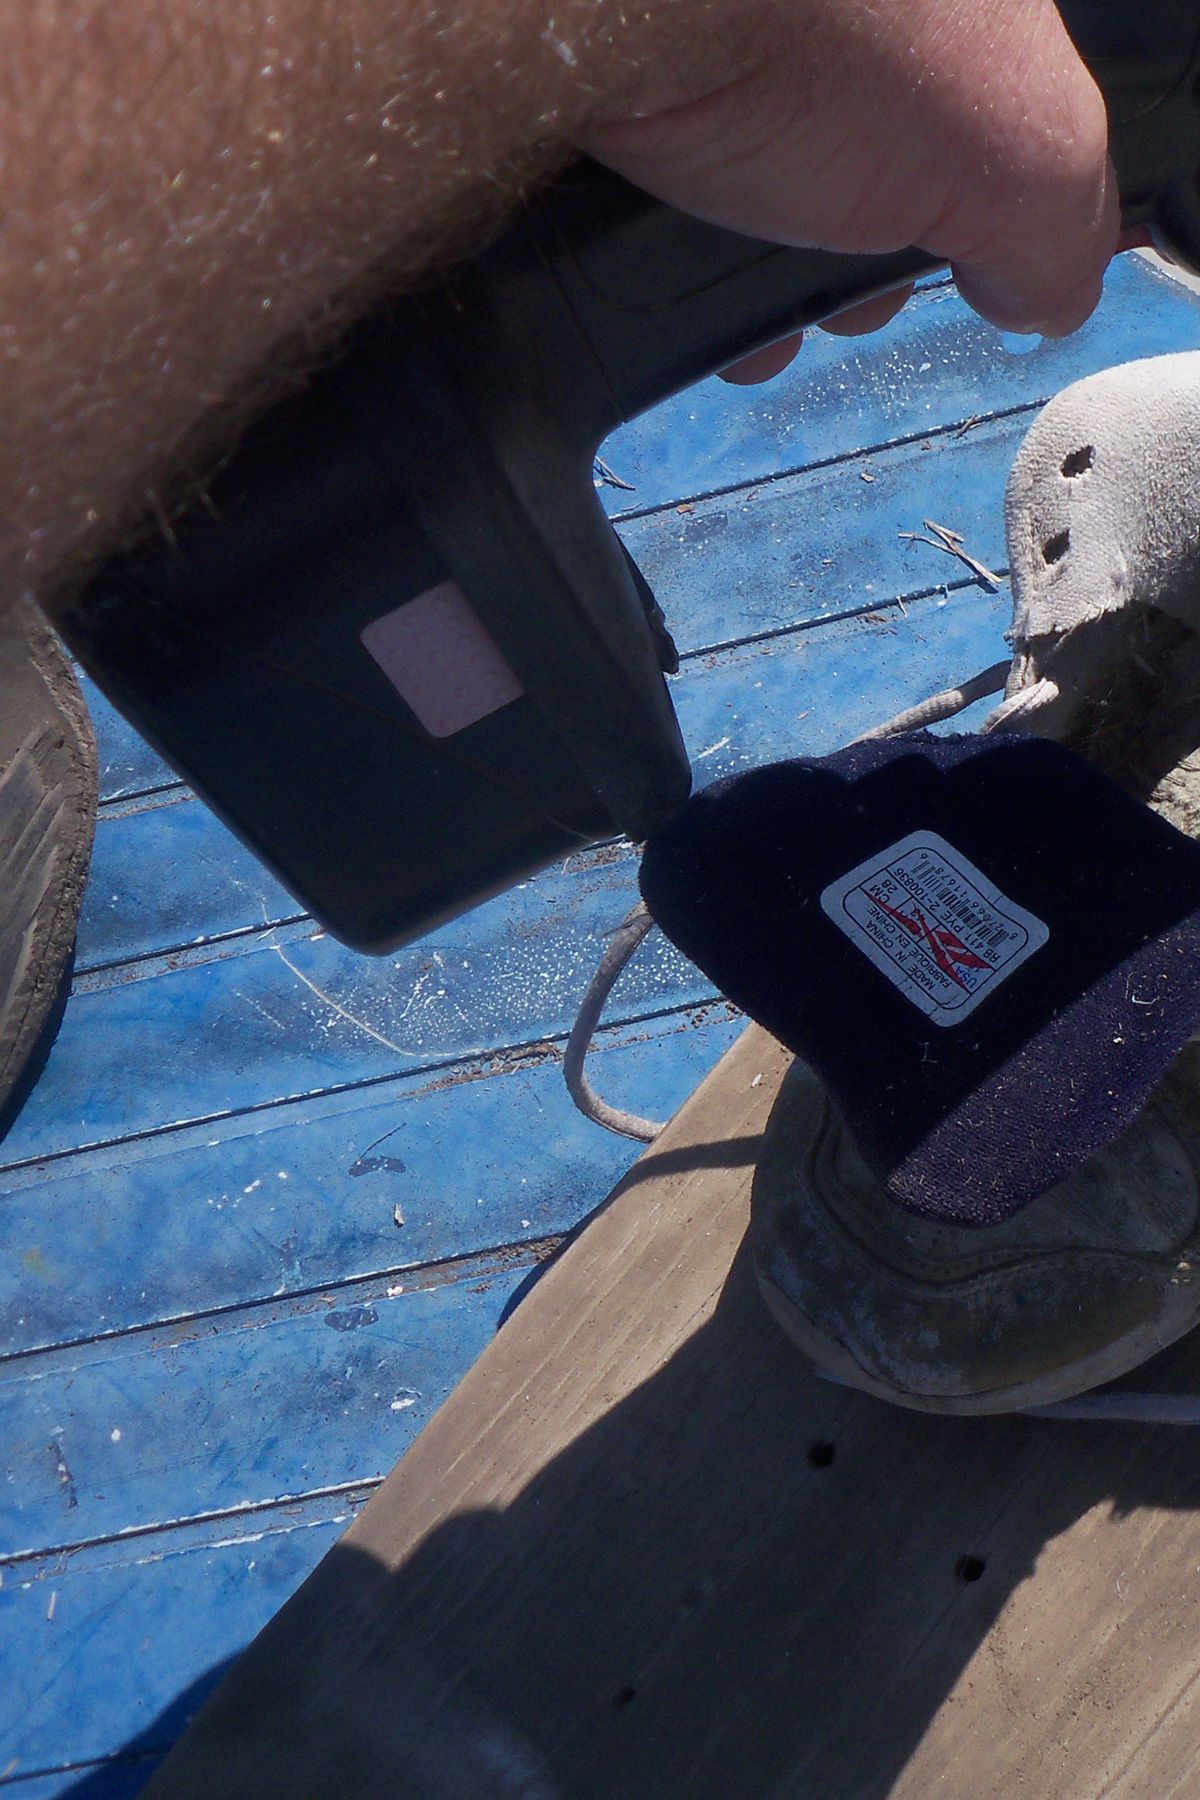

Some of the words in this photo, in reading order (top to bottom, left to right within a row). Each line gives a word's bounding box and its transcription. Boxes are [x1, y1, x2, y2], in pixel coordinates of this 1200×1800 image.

[918, 851, 928, 861] 6
[868, 883, 890, 904] CM
[880, 877, 898, 895] 28
[893, 866, 940, 912] 2-100836
[866, 905, 896, 934] CHINE
[940, 909, 964, 933] PYE
[864, 919, 894, 949] CHINA
[894, 933, 910, 948] EN
[964, 932, 984, 951] 411
[894, 950, 907, 963] IN
[982, 947, 1000, 963] RB
[908, 963, 935, 990] MADE
[953, 965, 978, 987] USA
